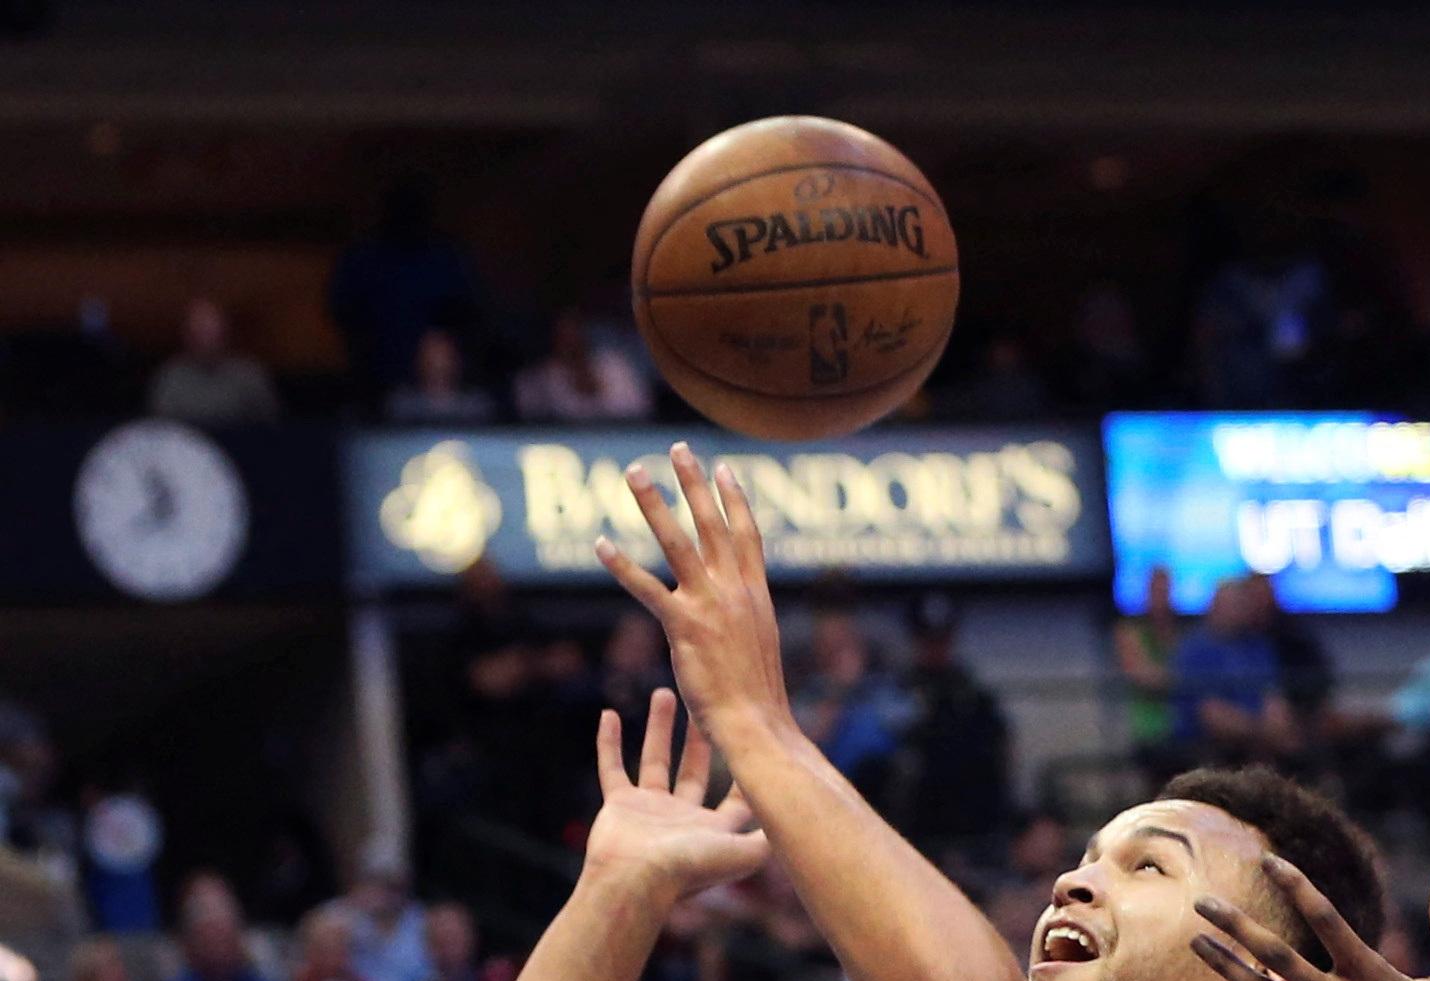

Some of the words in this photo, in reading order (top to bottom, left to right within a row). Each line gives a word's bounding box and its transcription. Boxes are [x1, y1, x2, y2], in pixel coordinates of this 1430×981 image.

[704, 203, 930, 274] SPALDING
[517, 439, 1081, 537] BACNDORF'S
[1236, 498, 1322, 573] UT
